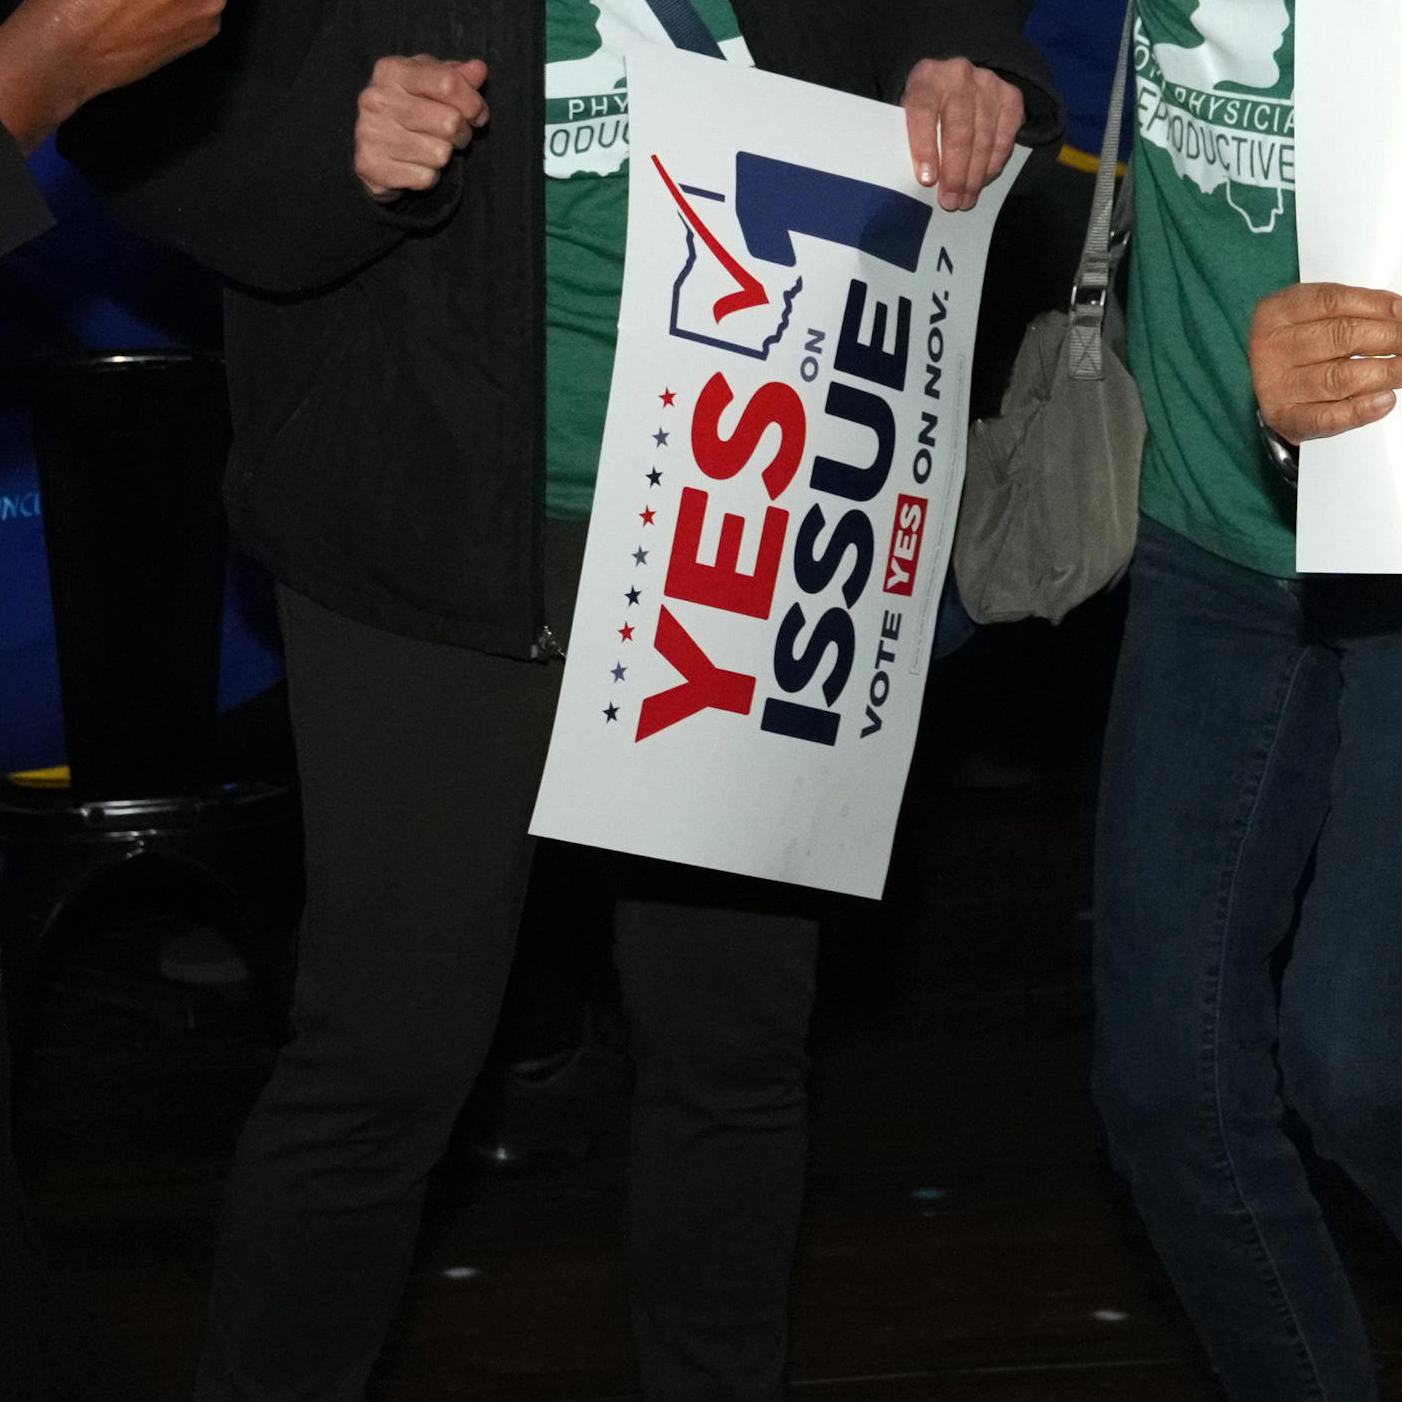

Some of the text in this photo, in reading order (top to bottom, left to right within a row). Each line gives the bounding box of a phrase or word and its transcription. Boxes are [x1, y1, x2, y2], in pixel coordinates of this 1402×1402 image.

[937, 246, 954, 275] 7
[924, 289, 950, 399] NOV.
[736, 151, 933, 746] ISSUE 1
[913, 411, 939, 484] ON
[636, 329, 825, 742] YES ON
[887, 502, 923, 591] YES
[862, 613, 903, 739] VOTE
